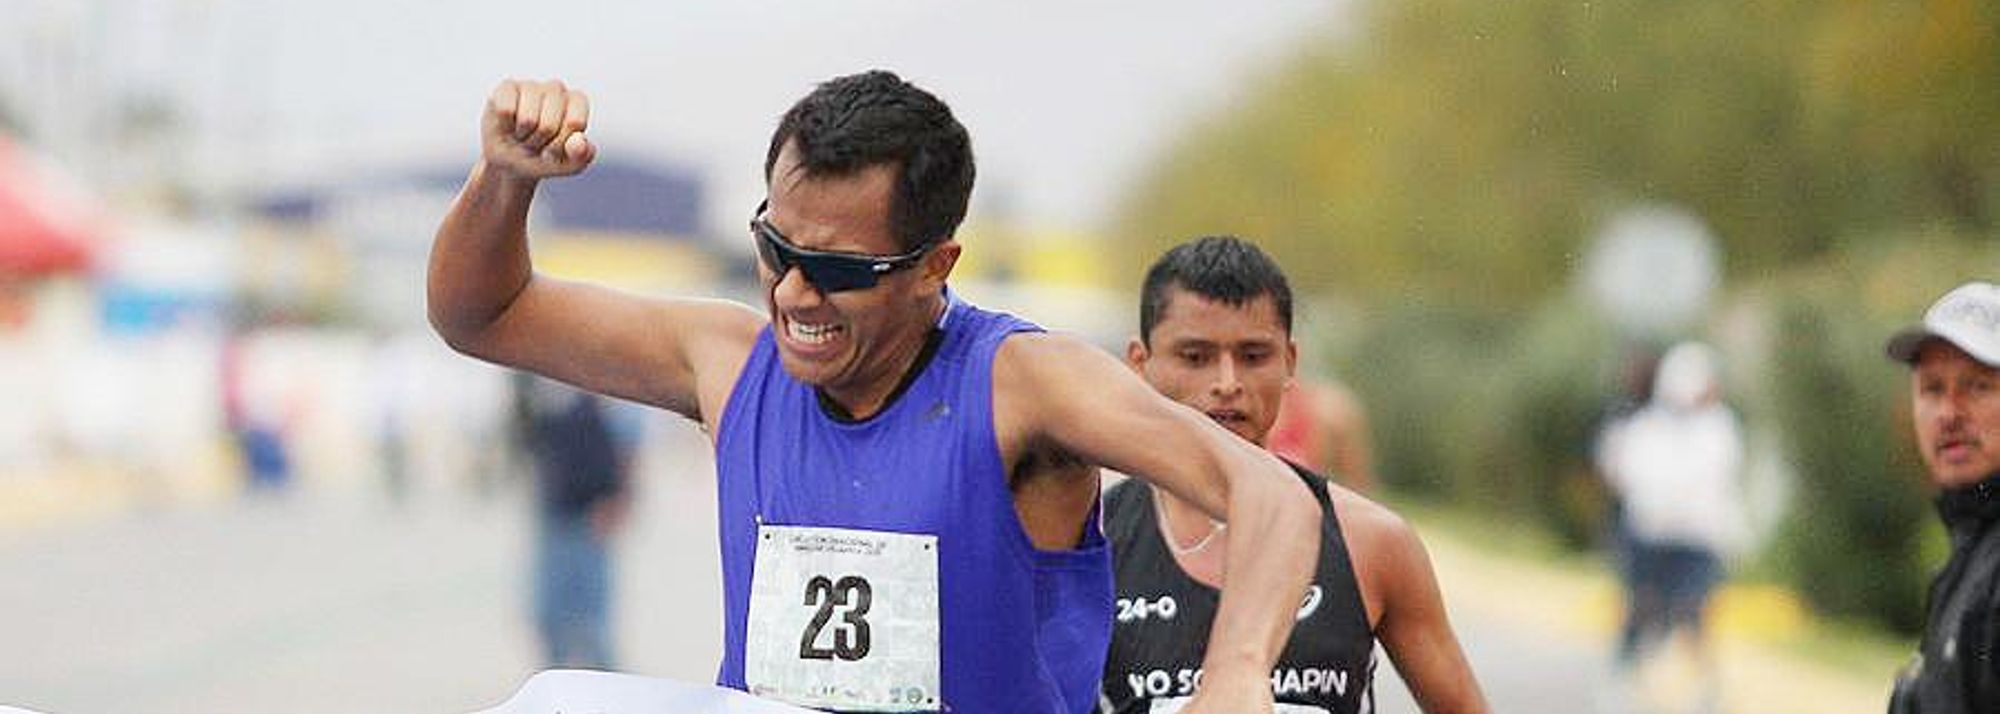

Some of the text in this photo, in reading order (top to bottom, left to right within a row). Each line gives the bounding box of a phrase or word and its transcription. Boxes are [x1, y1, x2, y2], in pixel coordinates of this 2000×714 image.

[800, 574, 872, 661] 23
[1128, 669, 1171, 697] YO
[1270, 667, 1348, 696] HAPIN
